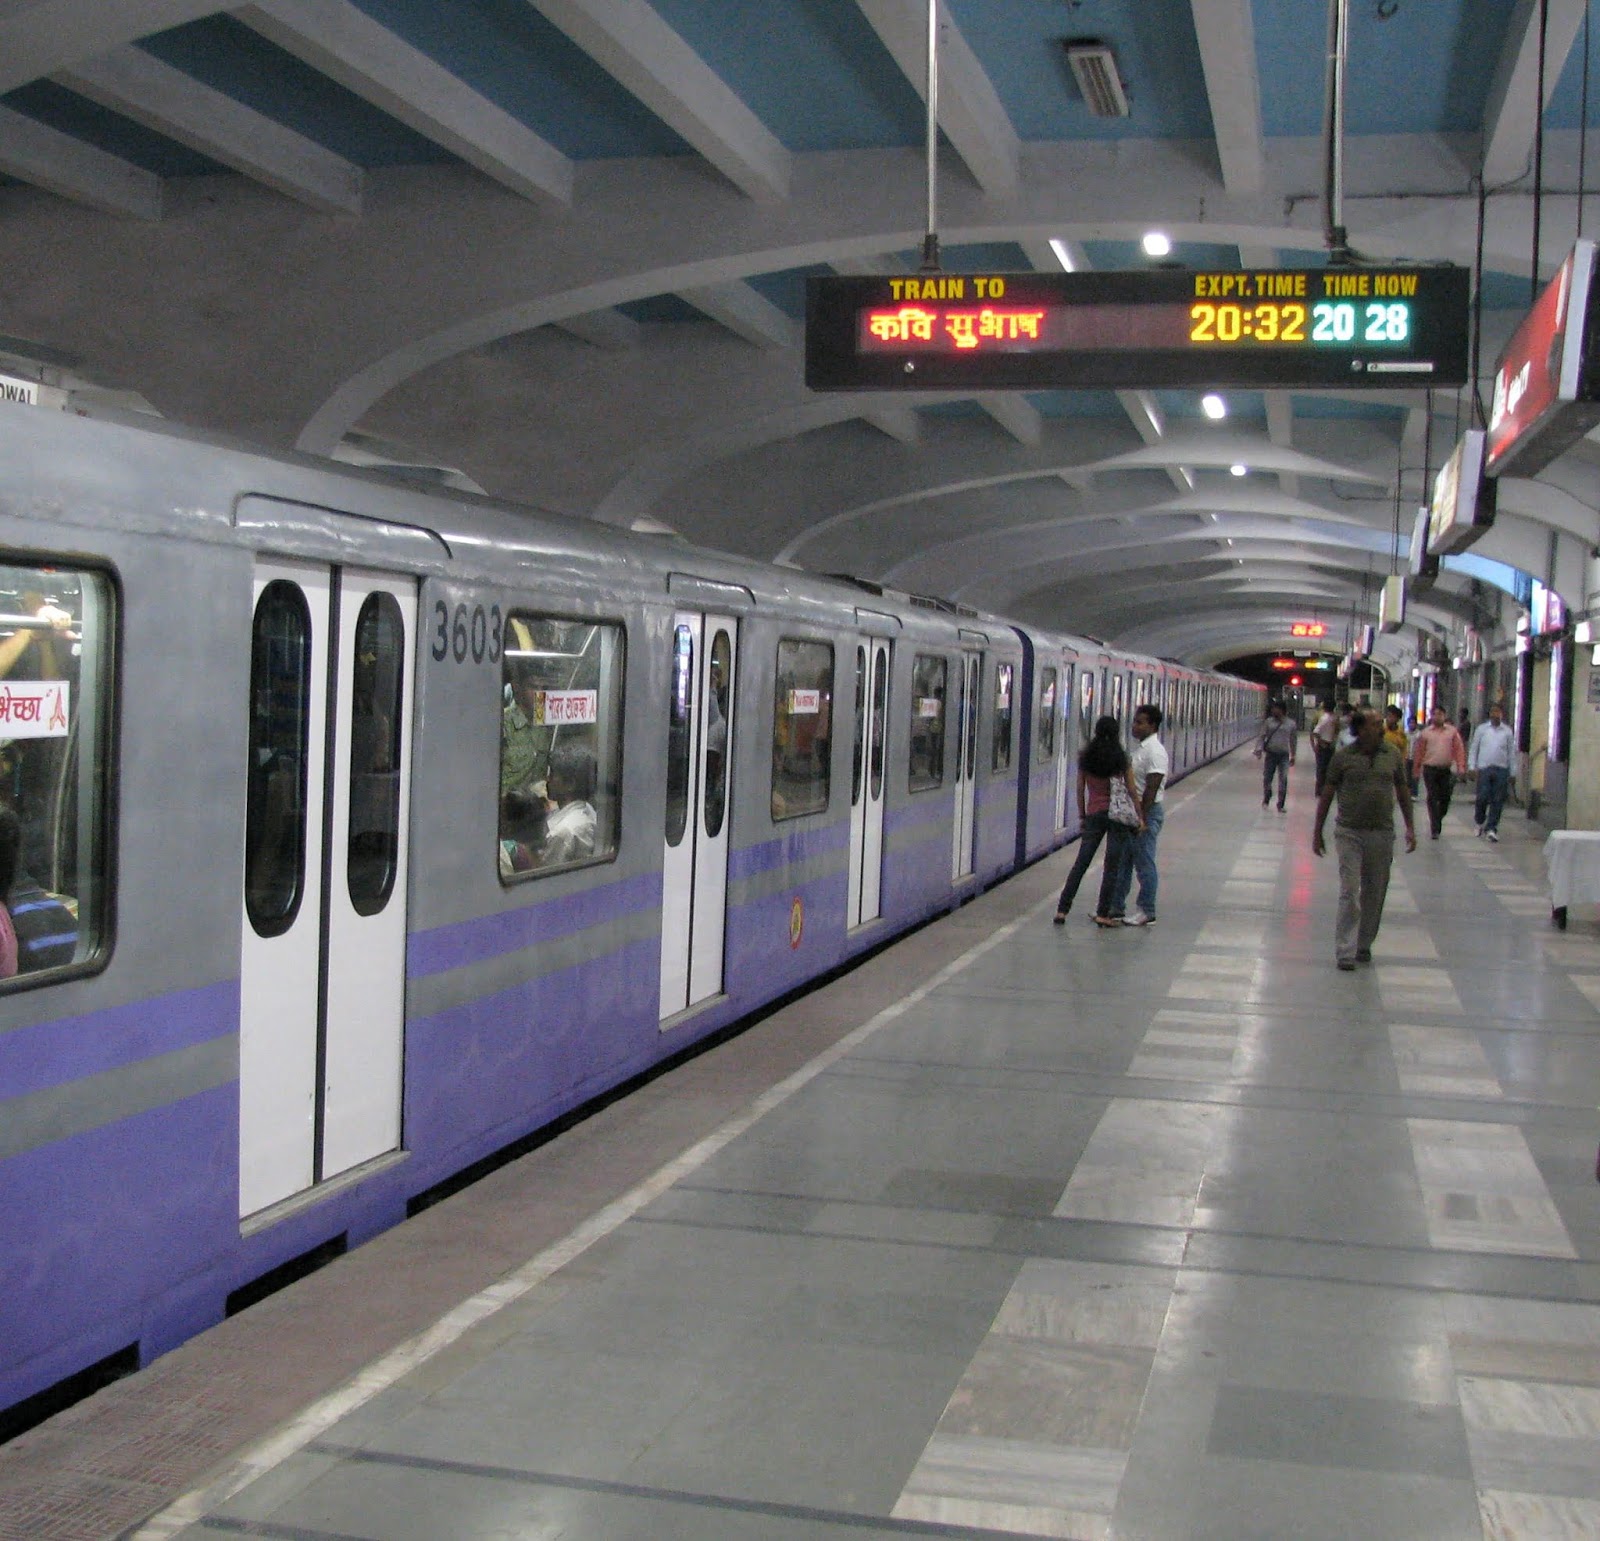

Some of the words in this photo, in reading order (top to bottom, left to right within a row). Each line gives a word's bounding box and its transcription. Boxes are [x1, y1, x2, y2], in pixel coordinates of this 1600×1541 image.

[890, 279, 964, 300] TRAIN
[973, 278, 1005, 298] TO
[1323, 275, 1369, 296] TIME
[1374, 275, 1418, 296] NOW
[870, 308, 937, 340] कवि
[1190, 304, 1305, 341] 20:32
[1312, 304, 1355, 341] 20
[1364, 304, 1409, 341] 28
[432, 600, 501, 664] 3603
